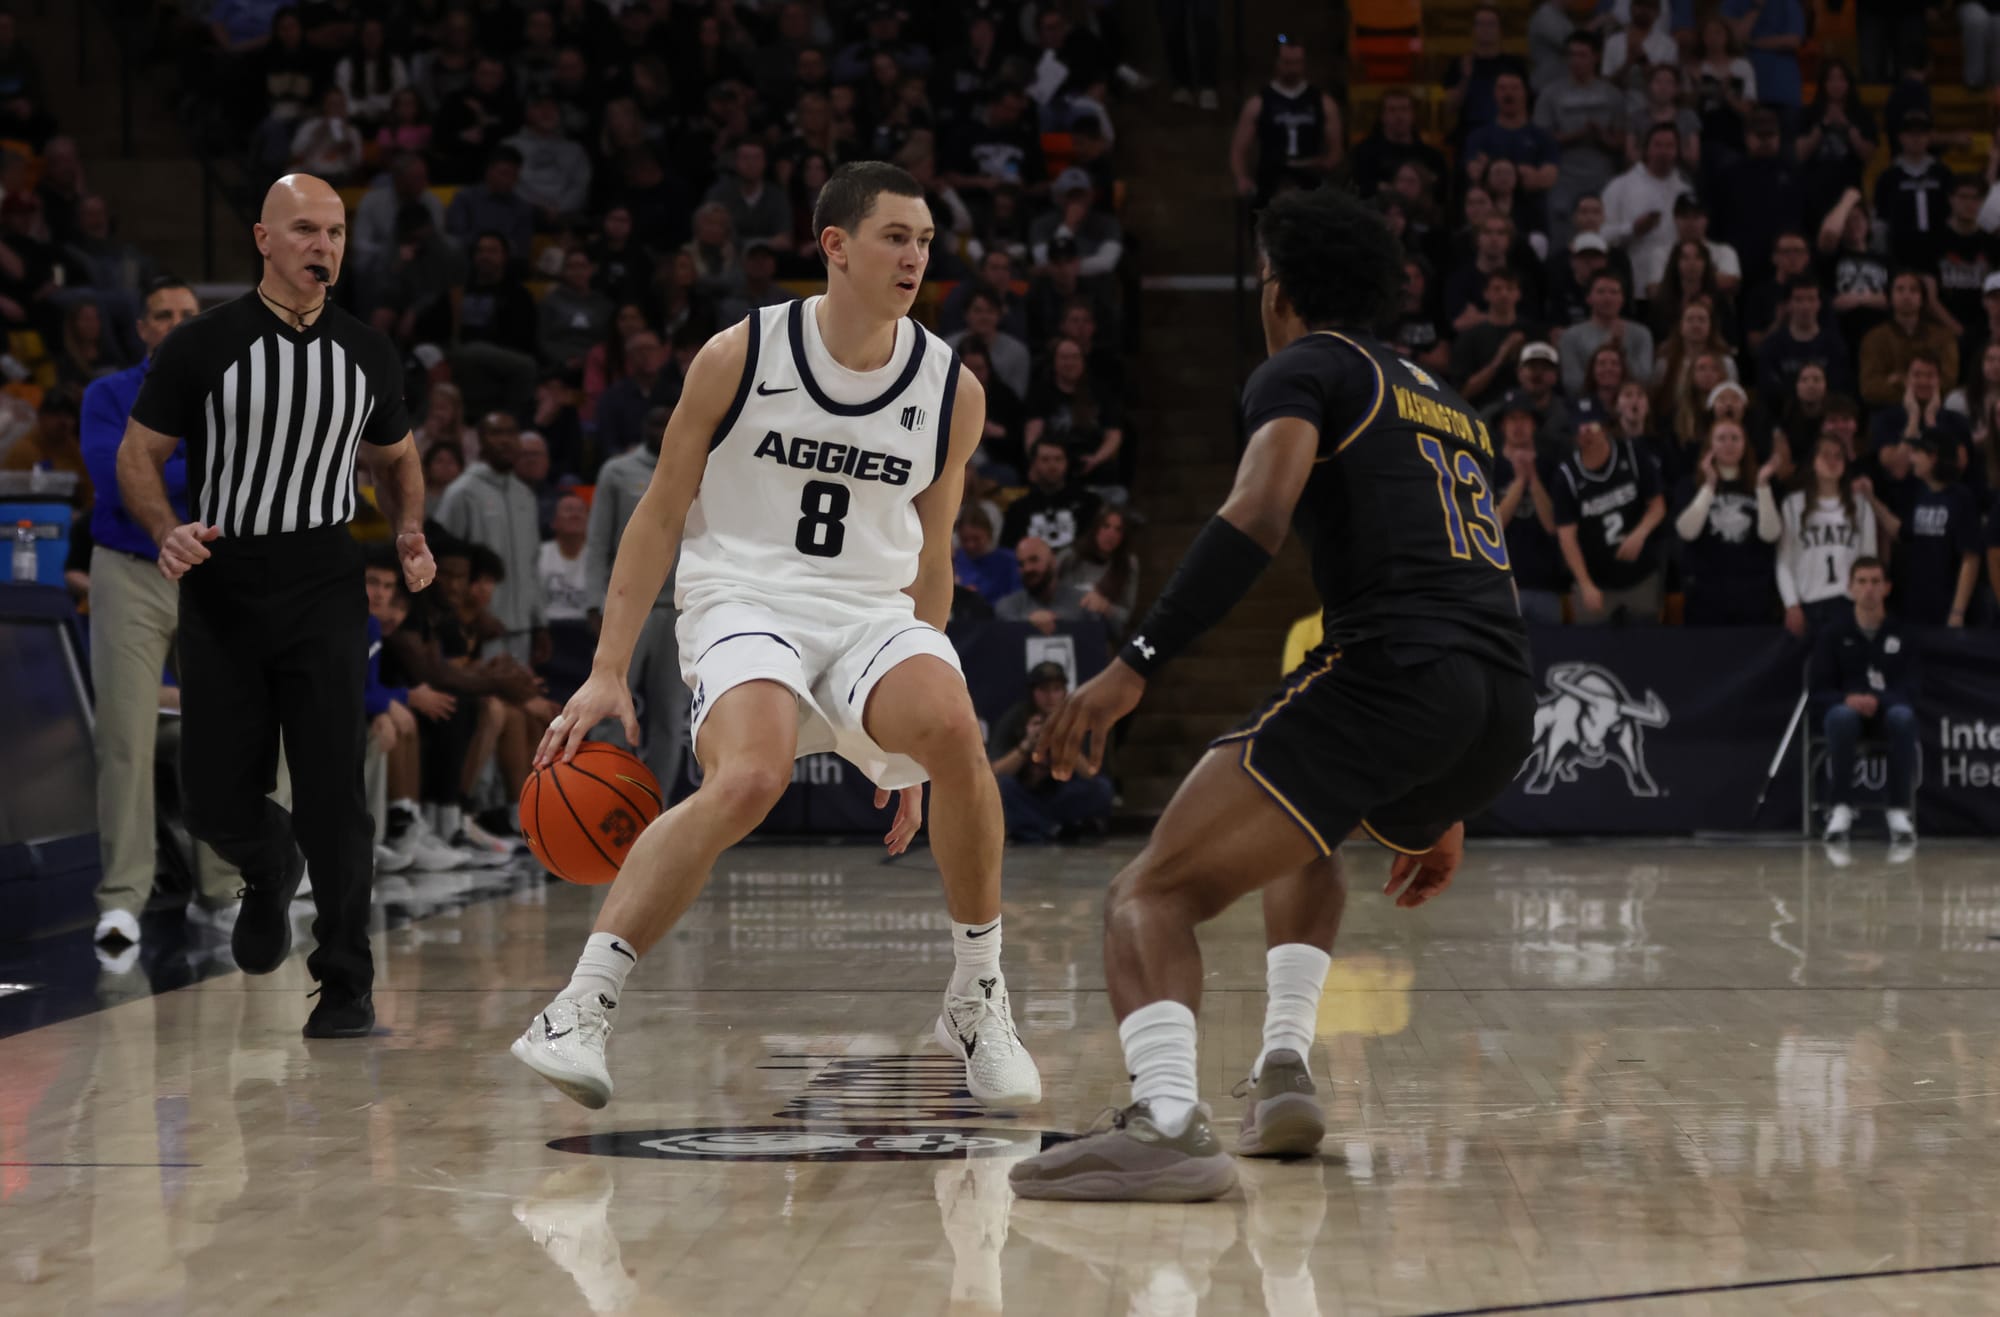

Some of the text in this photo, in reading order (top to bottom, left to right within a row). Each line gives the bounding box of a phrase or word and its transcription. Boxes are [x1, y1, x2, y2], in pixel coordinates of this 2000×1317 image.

[753, 430, 913, 486] AGGIES
[795, 480, 851, 558] 8
[1415, 431, 1512, 571] 13
[1602, 512, 1625, 546] 2
[1826, 555, 1838, 584] 1
